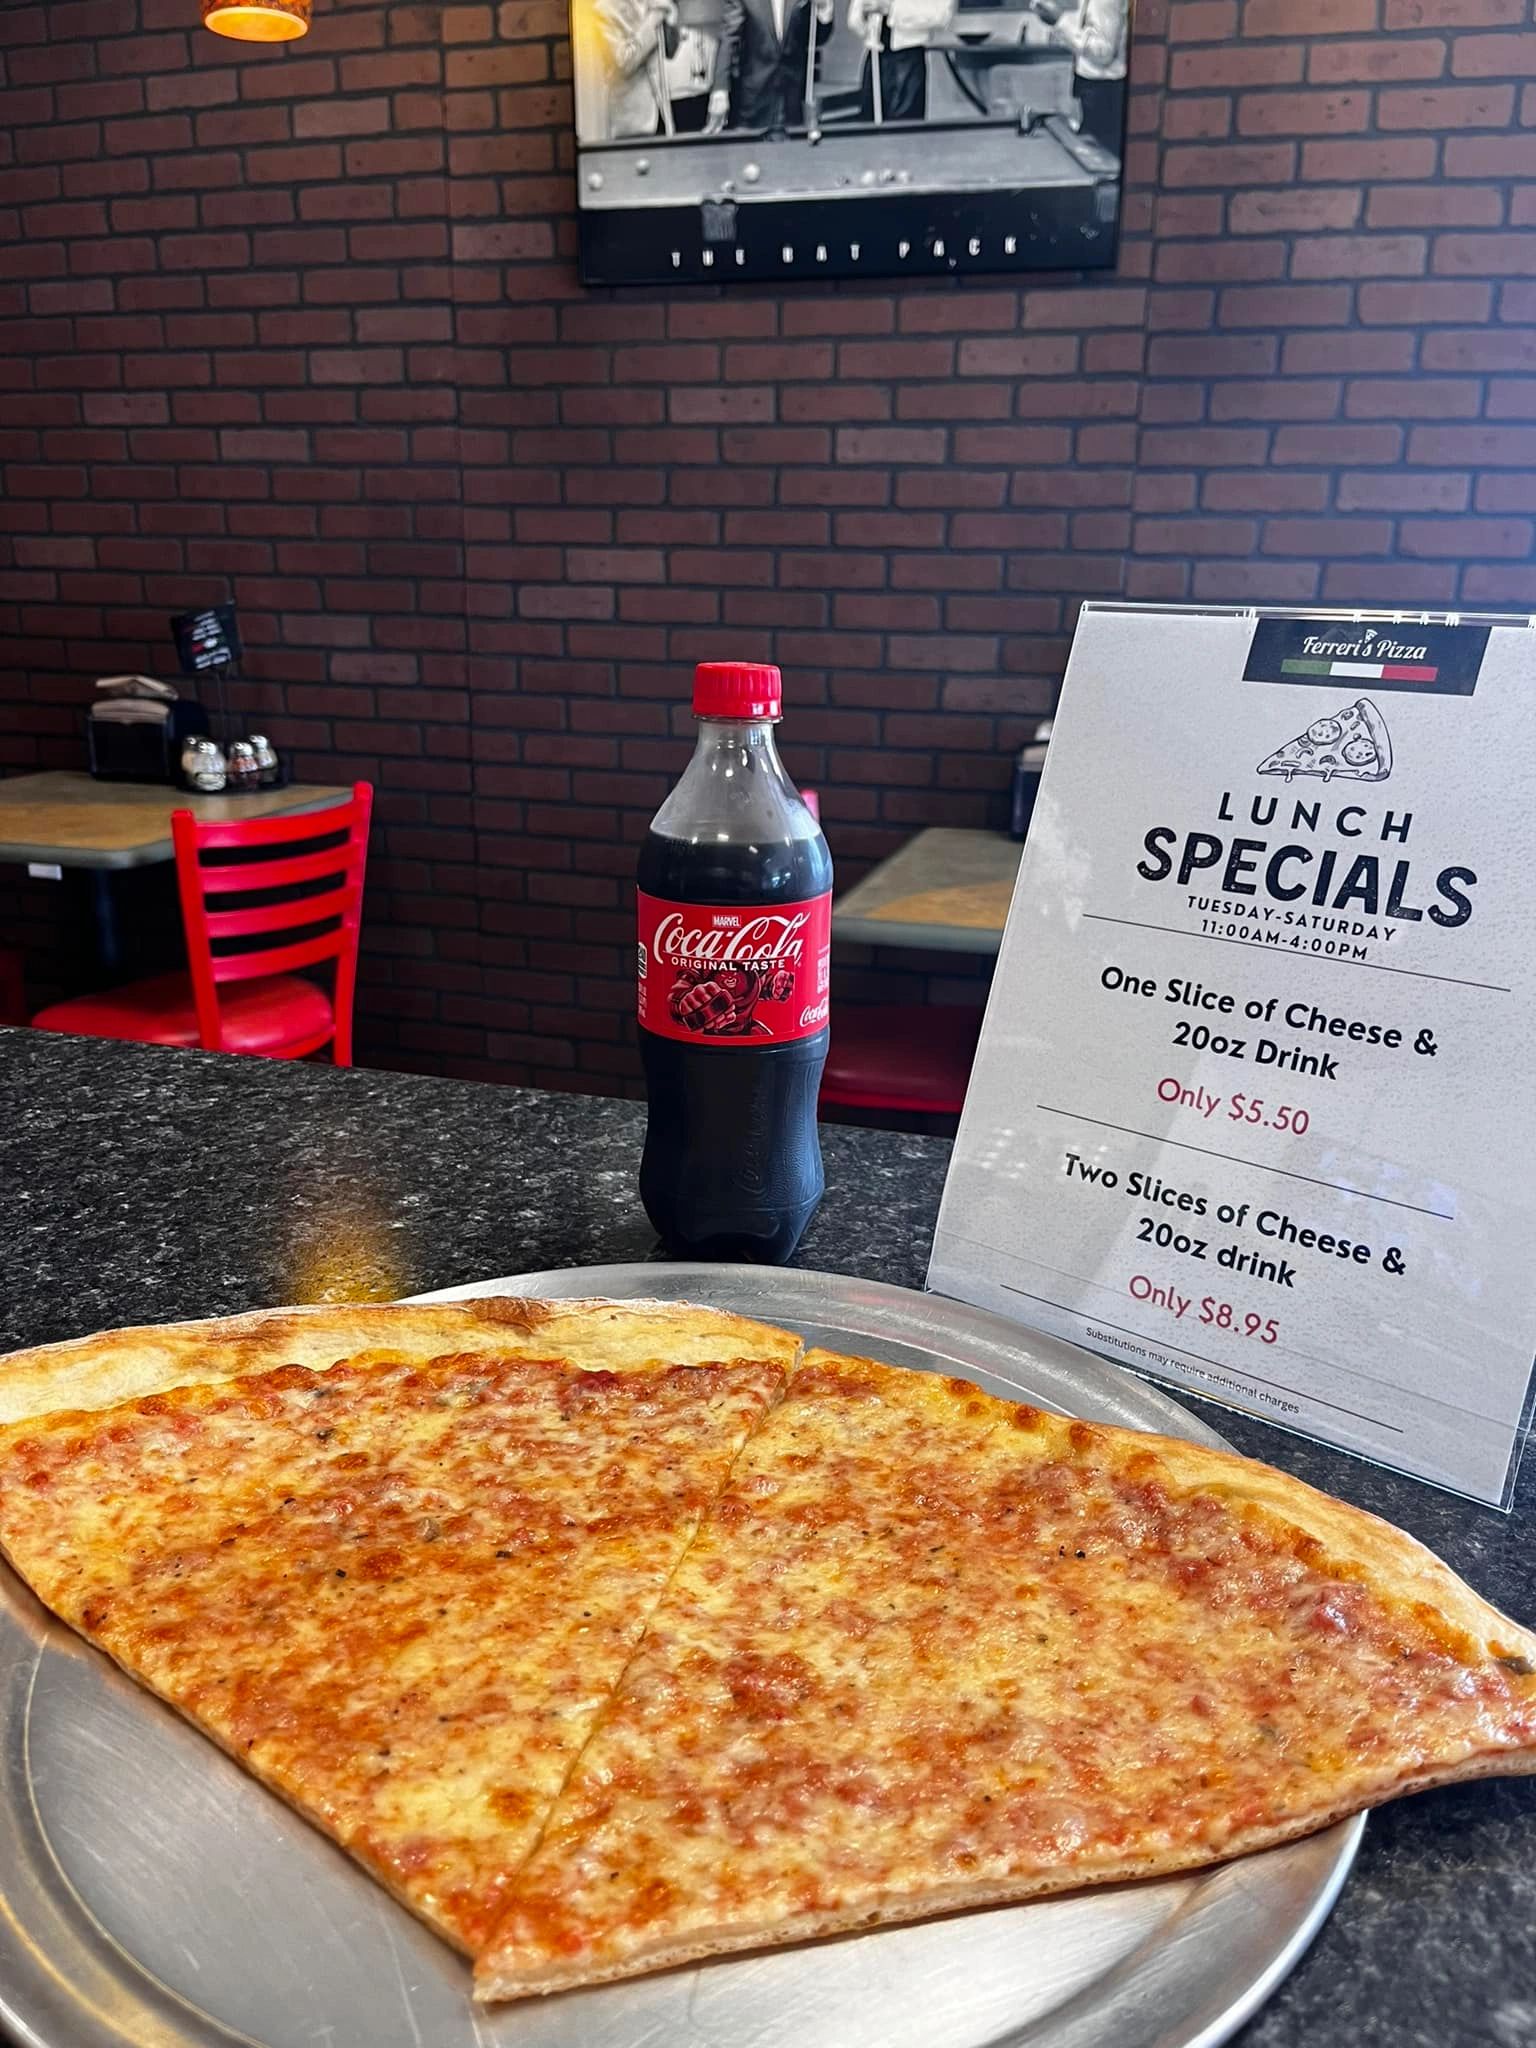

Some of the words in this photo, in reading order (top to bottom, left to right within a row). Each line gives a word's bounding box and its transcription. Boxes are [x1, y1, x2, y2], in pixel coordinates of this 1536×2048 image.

[898, 236, 1017, 259] PACK
[1303, 633, 1373, 657] Ferreri's
[1376, 639, 1428, 660] Pizza
[1217, 791, 1413, 843] LUNCH
[1136, 826, 1478, 928] SPECIALS
[653, 912, 811, 966] Coca-Cola
[712, 914, 741, 927] MARVEL
[1187, 895, 1397, 942] TUESDAY-SATURDAY
[1200, 918, 1368, 961] 11:00AM-4:00PM
[671, 956, 737, 971] ORIGINAL
[742, 959, 785, 971] TASTE
[1101, 966, 1157, 997] One
[1165, 978, 1235, 1014] Slice
[1244, 998, 1279, 1022] of
[1285, 1003, 1402, 1048] Cheese
[1413, 1028, 1438, 1057] &
[1172, 1021, 1245, 1059] 20oz
[1255, 1039, 1340, 1080] Drink
[1157, 1078, 1221, 1118] Only
[1228, 1093, 1310, 1135] $5.50
[1065, 1153, 1118, 1189] Two
[1126, 1172, 1208, 1216] Slices
[1217, 1204, 1250, 1228] of
[1256, 1210, 1371, 1265] Cheese
[1382, 1247, 1406, 1276] &
[1136, 1217, 1208, 1260] 20oz
[1217, 1245, 1297, 1288] drink
[1129, 1275, 1192, 1319] Only
[1199, 1296, 1280, 1345] $8.95
[1086, 1327, 1147, 1357] Substitutions
[1148, 1351, 1169, 1366] may
[1170, 1358, 1205, 1379] require
[1207, 1370, 1257, 1398] additional
[1259, 1391, 1300, 1414] charges
